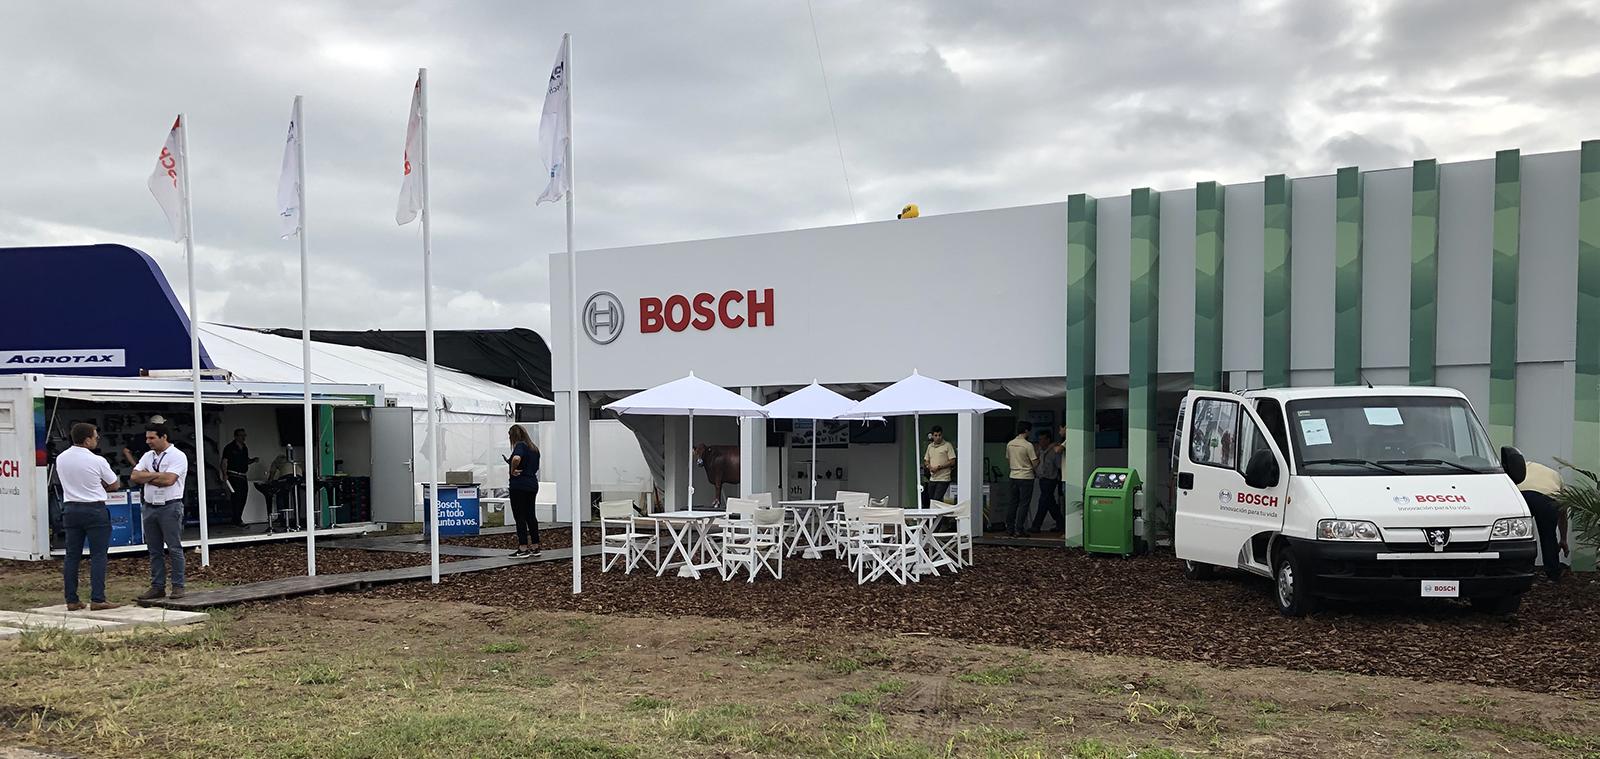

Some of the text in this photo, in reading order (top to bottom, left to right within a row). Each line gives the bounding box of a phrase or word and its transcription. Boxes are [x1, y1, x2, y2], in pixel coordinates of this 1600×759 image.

[640, 288, 774, 333] BOSCH
[6, 354, 114, 364] AGROTAX
[437, 500, 462, 508] Bosch.
[1238, 492, 1278, 507] BOSCH
[447, 509, 464, 517] todo
[1220, 505, 1247, 513] Innovación
